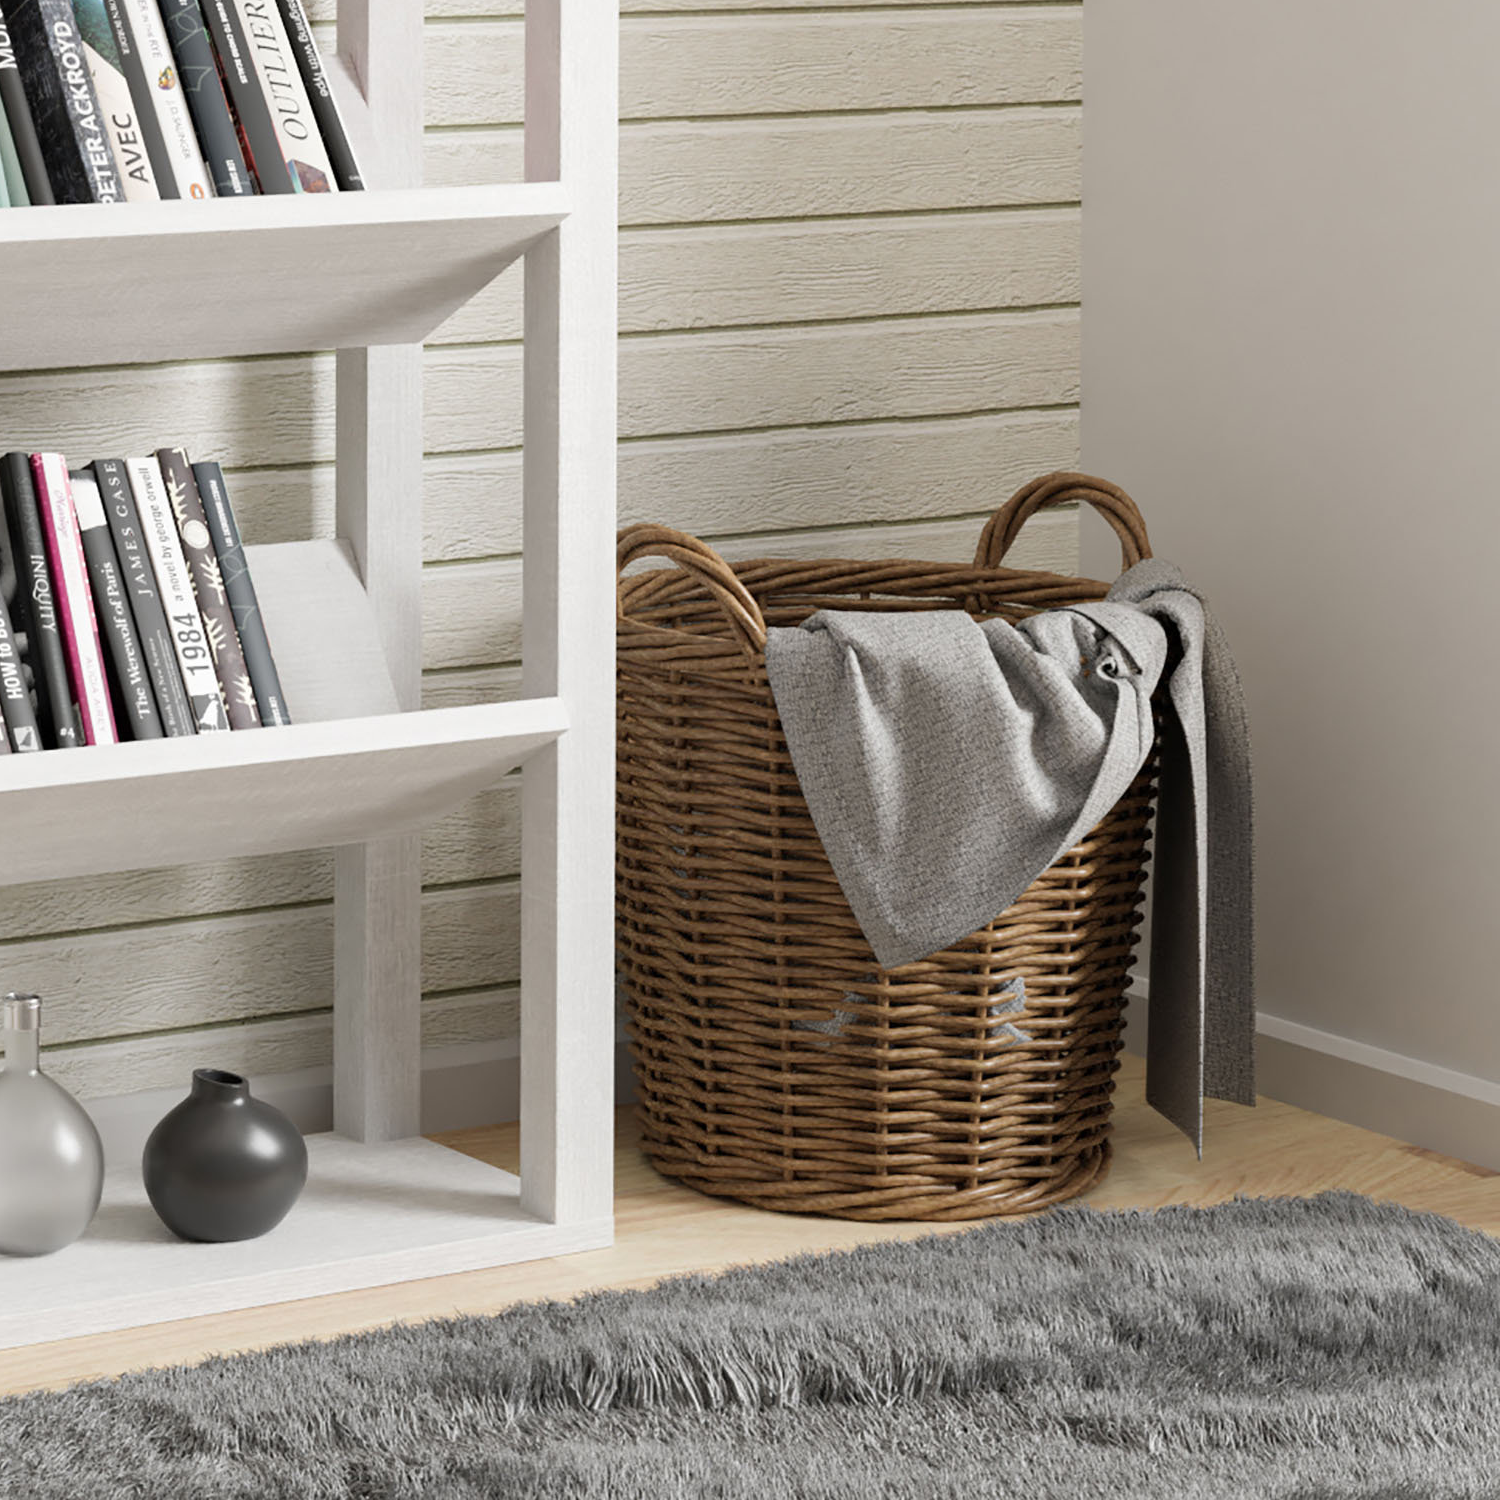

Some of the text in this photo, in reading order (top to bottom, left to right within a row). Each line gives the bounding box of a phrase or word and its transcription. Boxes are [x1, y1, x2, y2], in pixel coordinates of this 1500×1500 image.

[148, 40, 164, 58] RYE
[222, 22, 232, 34] TO
[54, 21, 100, 131] ACKROYD
[304, 43, 320, 70] with
[312, 70, 330, 98] Type
[111, 112, 149, 183] AVEC
[31, 553, 57, 633] INIQUITY
[121, 526, 154, 598] JAMES
[137, 467, 211, 676] 1984 a novel by george orwell
[100, 561, 151, 720] The Werewolf of Paris
[0, 661, 24, 699] HOW
[157, 668, 166, 686] New
